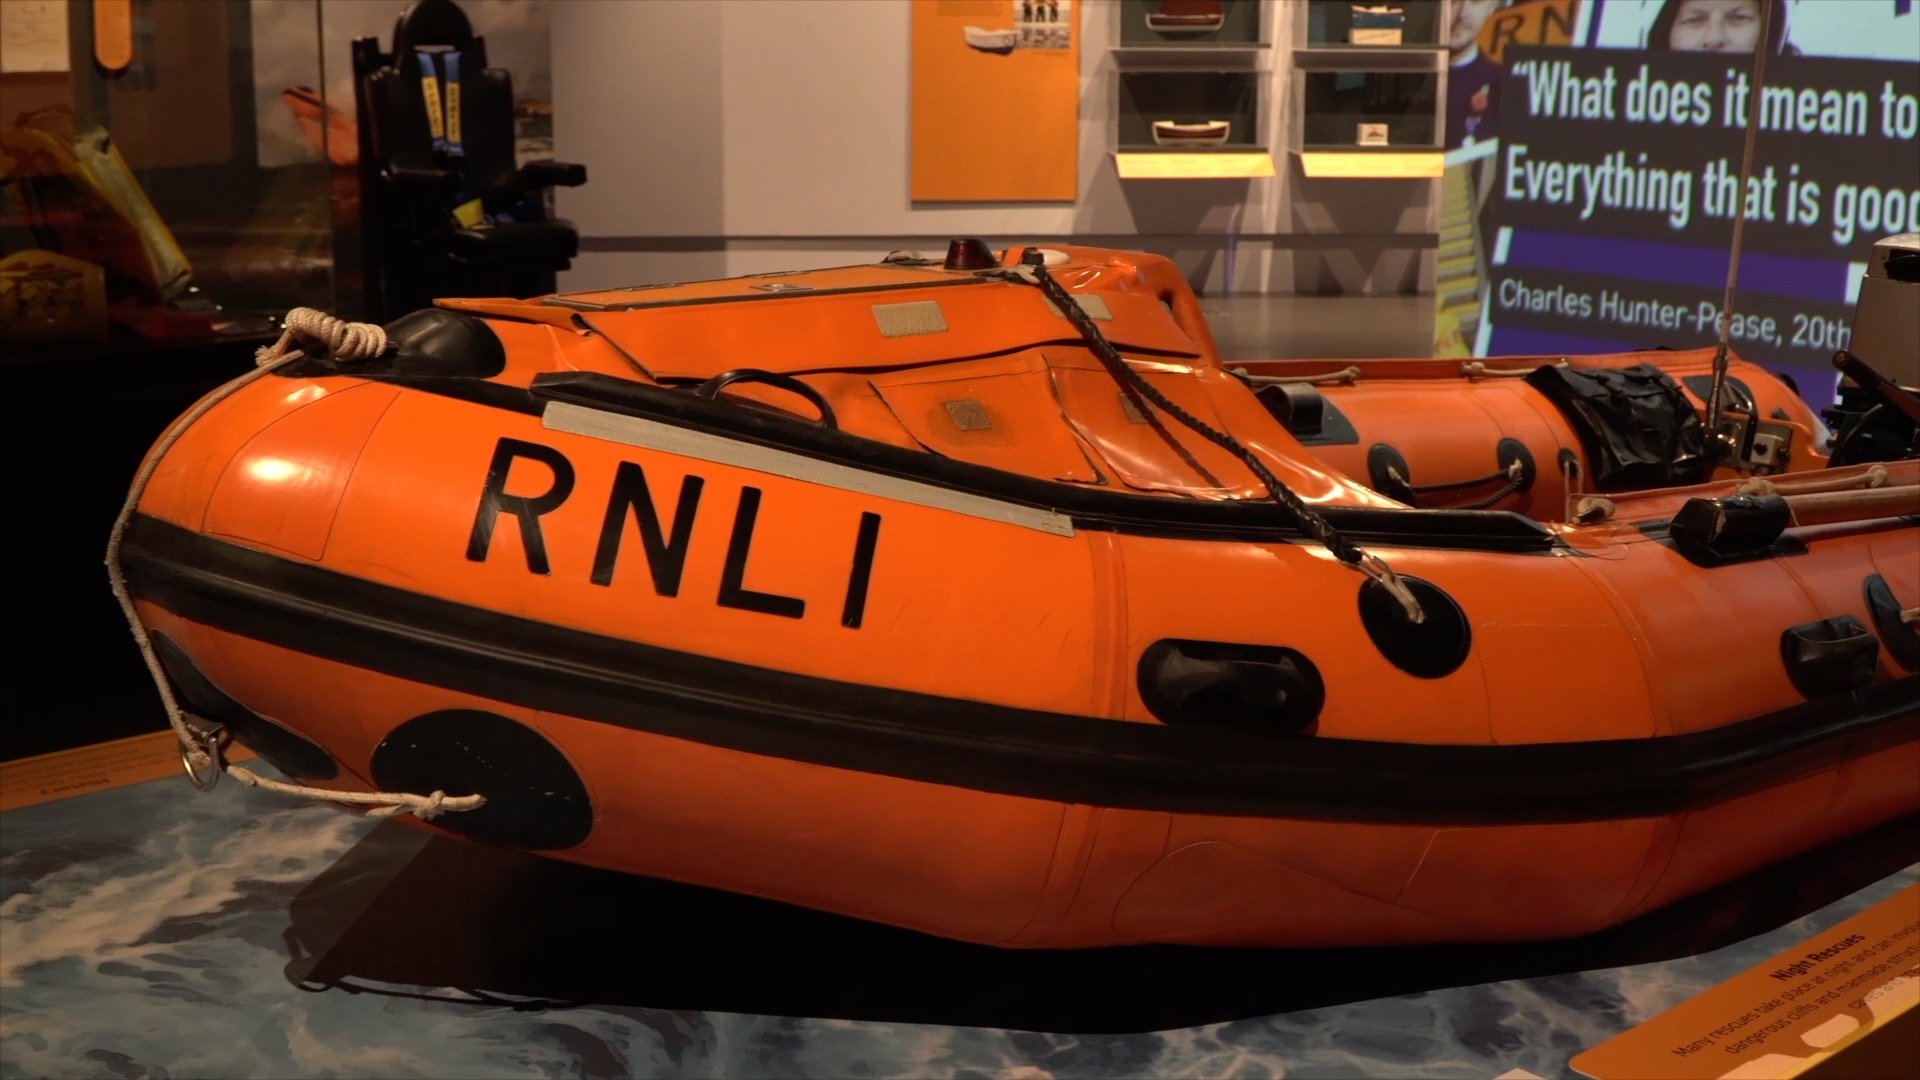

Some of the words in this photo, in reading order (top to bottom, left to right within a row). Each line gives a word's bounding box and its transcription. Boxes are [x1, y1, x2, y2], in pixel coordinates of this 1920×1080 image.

[1625, 64, 1713, 126] does
[1723, 68, 1749, 128] it
[1759, 85, 1868, 136] mean
[1880, 80, 1919, 140] to
[1505, 143, 1693, 230] Everything
[1702, 157, 1777, 222] that
[1785, 163, 1821, 226] is
[1500, 278, 1592, 318] Charles
[1791, 313, 1851, 349] 20th
[465, 436, 882, 630] RNLI
[1672, 1036, 1715, 1057] Many
[1709, 1012, 1760, 1039] rescues
[1754, 998, 1785, 1014] take
[1781, 983, 1816, 1002] place
[1811, 975, 1829, 985] at
[1824, 961, 1857, 978] night
[1851, 948, 1877, 963] and
[1871, 939, 1896, 951] can
[1769, 960, 1816, 981] Night
[1806, 934, 1866, 962] Rescues
[1725, 1018, 1791, 1054] dangerous
[1787, 1003, 1819, 1020] cliffs
[1815, 990, 1841, 1005] and
[1836, 963, 1891, 993] manmade
